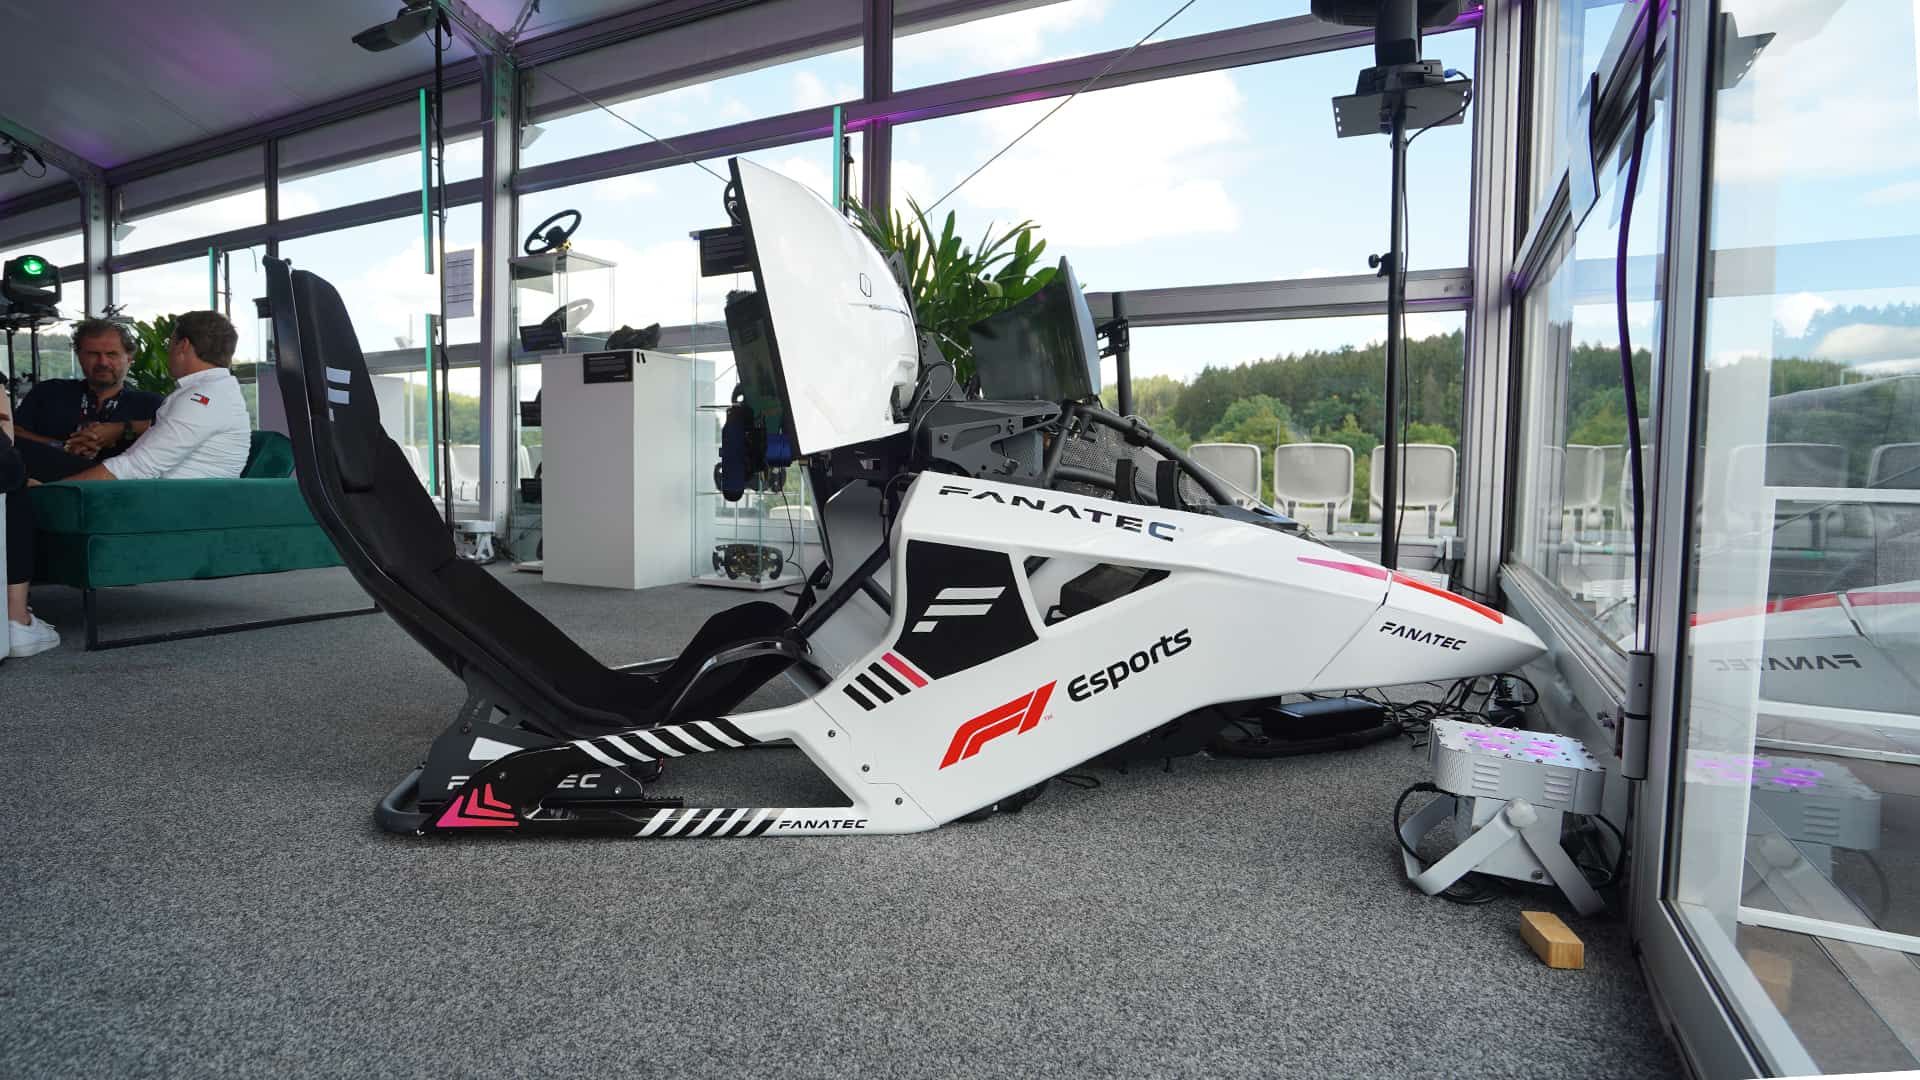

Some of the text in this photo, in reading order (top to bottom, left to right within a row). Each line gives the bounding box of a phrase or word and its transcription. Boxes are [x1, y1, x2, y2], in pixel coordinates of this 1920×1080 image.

[938, 485, 1177, 542] FANATEC
[1379, 621, 1467, 651] FANATEC
[1066, 628, 1193, 702] Esports
[778, 819, 869, 829] FANATEC
